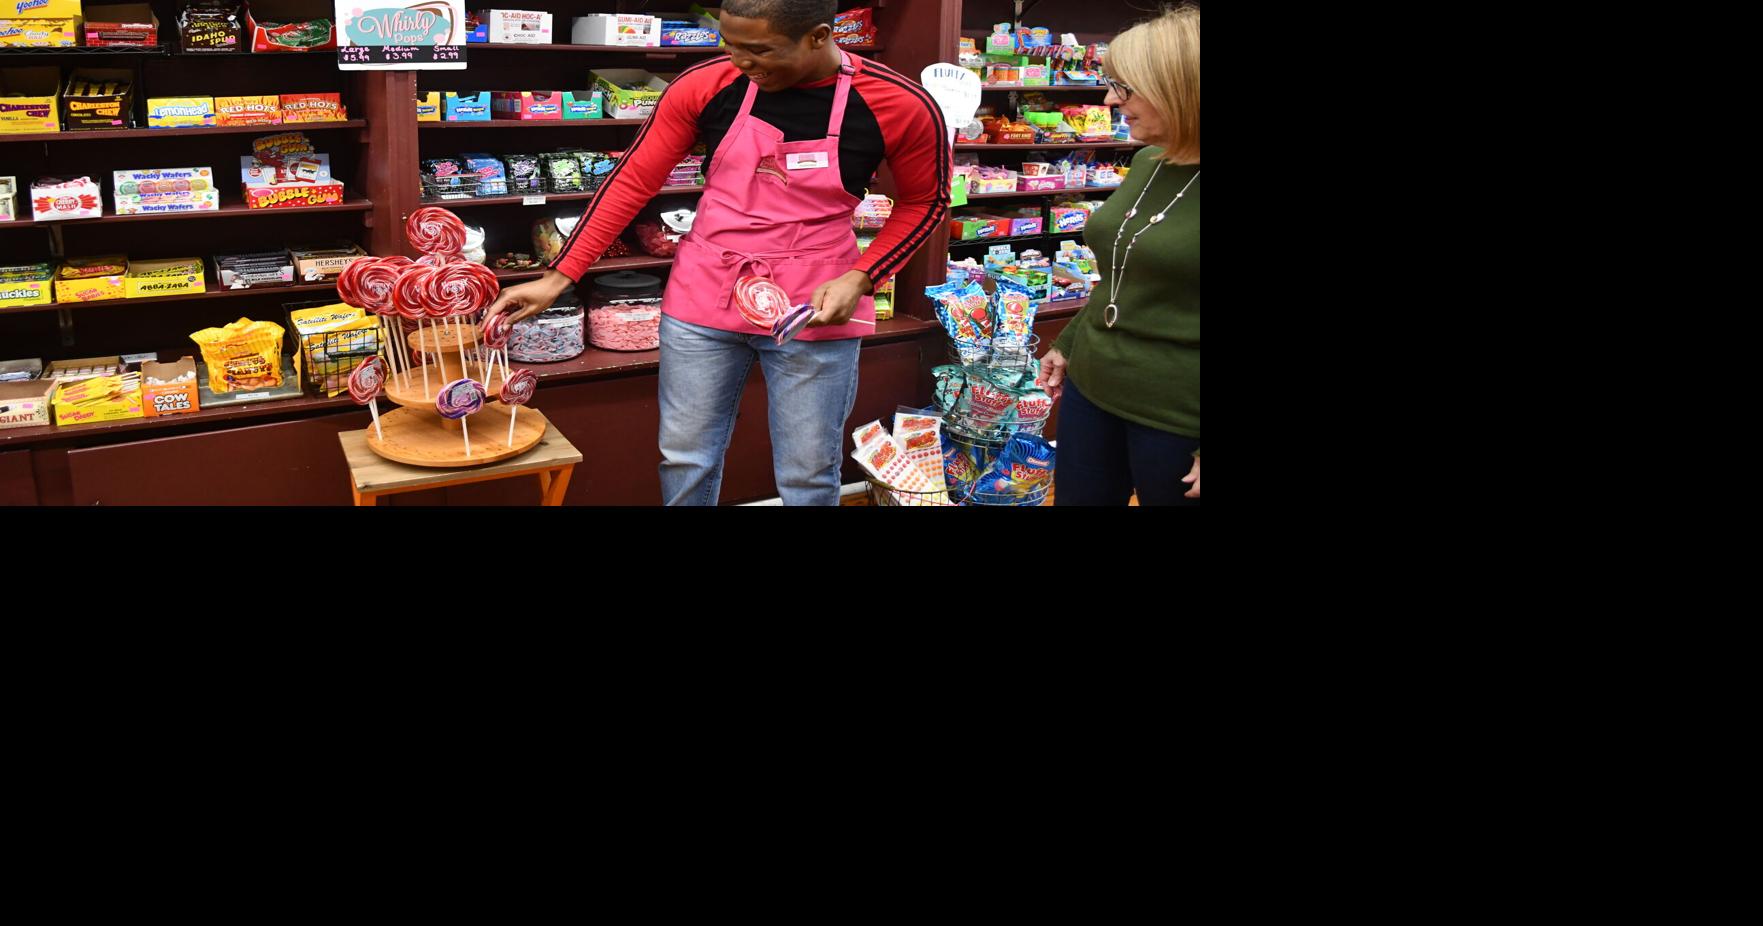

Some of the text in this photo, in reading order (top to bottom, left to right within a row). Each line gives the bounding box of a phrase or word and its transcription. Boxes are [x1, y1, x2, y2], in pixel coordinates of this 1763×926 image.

[357, 10, 437, 39] Whirly
[191, 30, 226, 43] IDAHO
[394, 33, 424, 43] Pops
[341, 46, 370, 56] Large
[69, 101, 120, 111] CHARLESTON
[220, 104, 276, 113] RED HOTS
[309, 101, 338, 110] HOTS
[26, 110, 50, 118] CHEW
[96, 109, 120, 117] CHEW
[132, 172, 161, 180] Wacky
[257, 187, 310, 208] BUBBLE
[307, 192, 339, 205] GUM
[142, 204, 166, 212] Wacky
[0, 288, 40, 299] uckles
[154, 393, 188, 404] COW
[154, 401, 191, 412] TALES
[0, 413, 35, 424] GIANT
